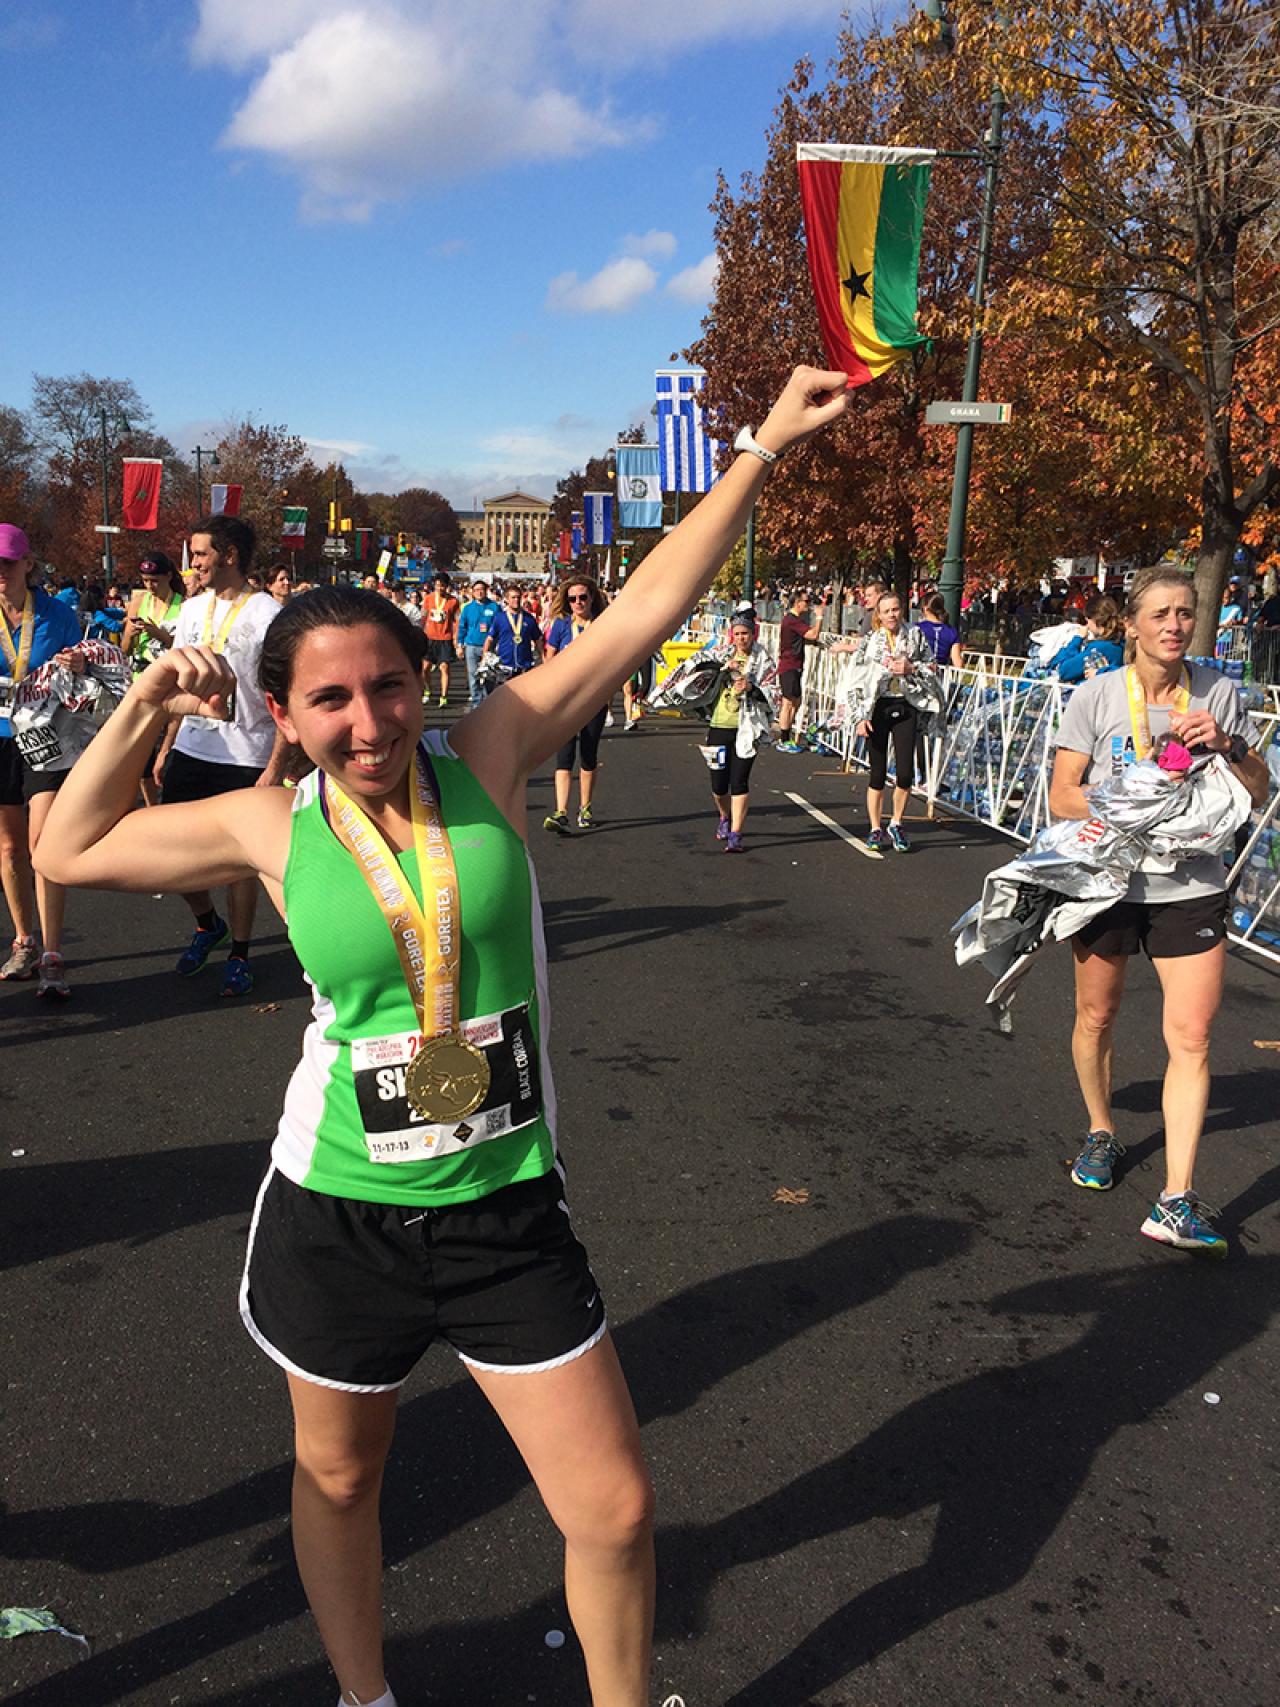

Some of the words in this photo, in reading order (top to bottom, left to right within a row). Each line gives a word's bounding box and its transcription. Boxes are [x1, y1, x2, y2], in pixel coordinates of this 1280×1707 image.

[949, 407, 981, 417] GHANA
[426, 845, 448, 859] 20
[376, 1066, 409, 1101] SH
[372, 1140, 410, 1154] 11-17-13
